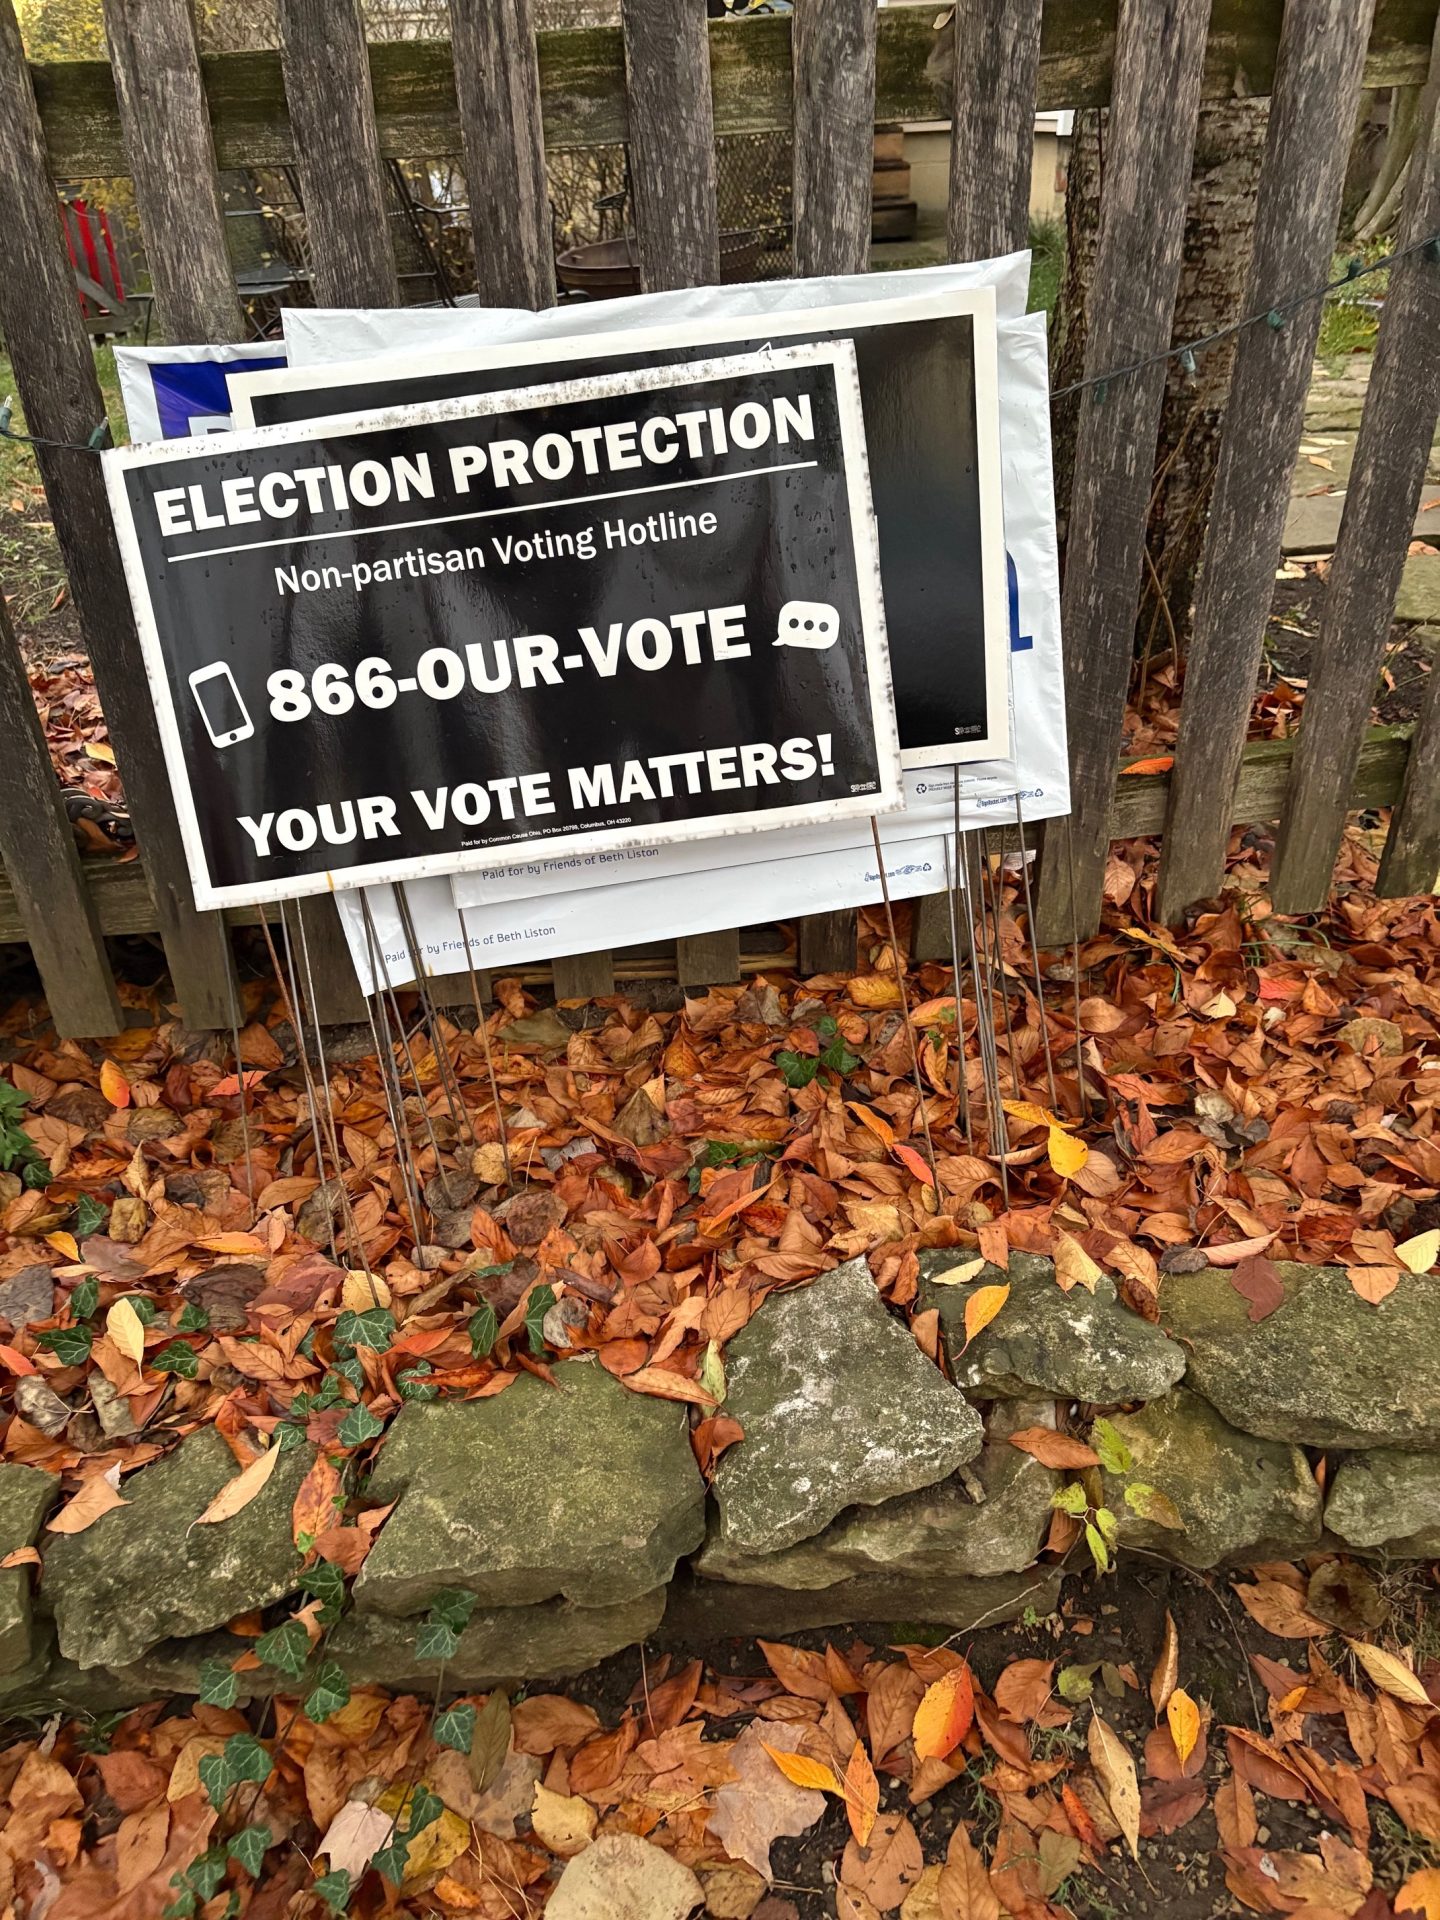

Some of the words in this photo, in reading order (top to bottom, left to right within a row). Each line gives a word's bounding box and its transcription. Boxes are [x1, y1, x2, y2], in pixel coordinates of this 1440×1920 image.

[153, 452, 435, 537] ELECTION
[454, 393, 814, 491] PROTECTION
[274, 548, 484, 596] Non-partisan
[492, 524, 596, 568] Voting
[604, 511, 718, 550] Hotline
[267, 605, 752, 722] 866-OUR-VOTE
[237, 796, 401, 857] YOUR
[410, 773, 555, 830] VOTE
[567, 734, 835, 810] MATTERS!
[461, 839, 473, 847] Paid
[481, 837, 489, 845] by
[488, 834, 512, 843] Common
[511, 832, 528, 840] Cause
[482, 867, 505, 881] Paid
[509, 866, 524, 877] for
[528, 863, 541, 874] by
[543, 858, 582, 872] Friends
[584, 855, 596, 866] of
[599, 852, 625, 863] Beth
[627, 848, 659, 860] Liston
[385, 950, 406, 964] Paid
[426, 944, 440, 955] by
[482, 934, 495, 946] of
[497, 930, 522, 943] Beth
[524, 925, 556, 939] Liston
